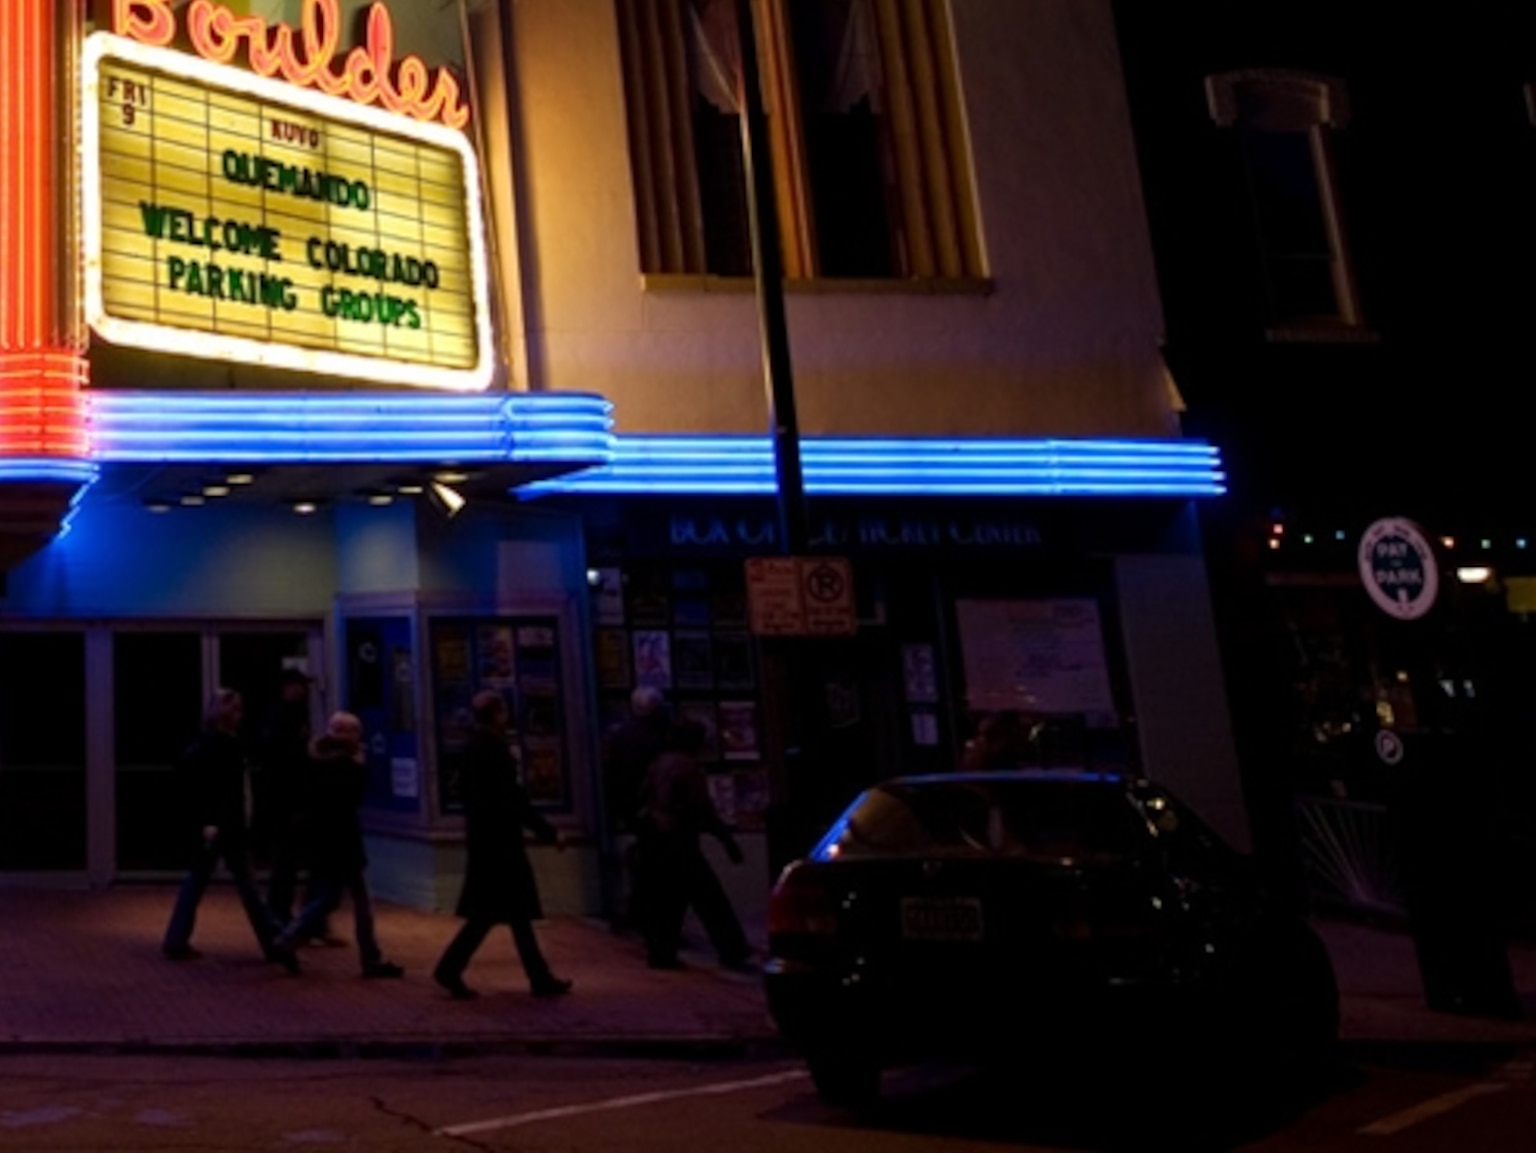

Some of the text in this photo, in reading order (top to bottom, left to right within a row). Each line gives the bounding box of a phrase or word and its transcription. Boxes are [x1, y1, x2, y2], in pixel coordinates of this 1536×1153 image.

[107, 77, 146, 105] FRI
[122, 104, 136, 126] 9
[272, 119, 320, 148] KUVO
[222, 148, 370, 210] QUEMANDO
[138, 200, 439, 289] WELCOME COLORADO
[168, 255, 422, 330] PARKING GROUPS
